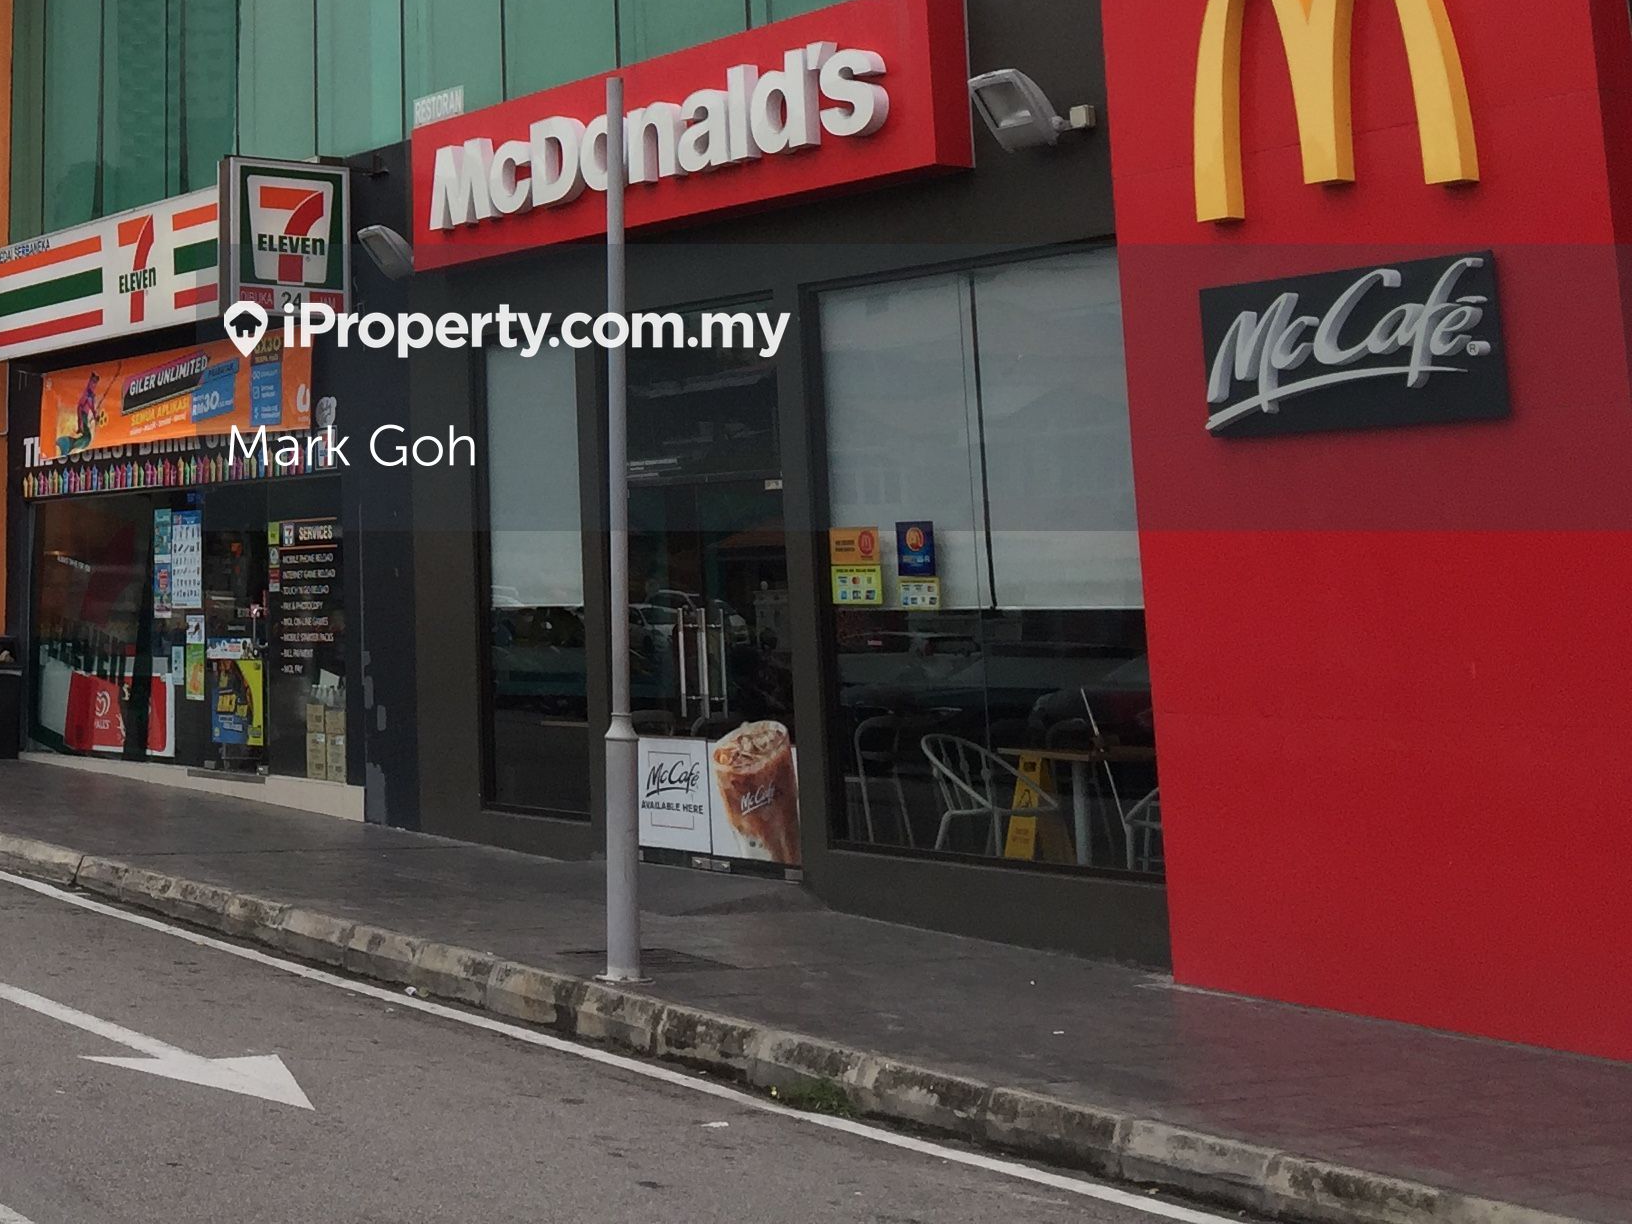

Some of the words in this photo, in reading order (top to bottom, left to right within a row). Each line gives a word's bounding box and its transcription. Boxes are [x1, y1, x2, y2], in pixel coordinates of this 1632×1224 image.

[416, 87, 463, 124] RESTORAN
[429, 41, 889, 231] McDonald's
[260, 186, 324, 283] 7
[118, 214, 155, 324] 7
[281, 291, 302, 311] 24
[129, 376, 156, 397] GILER
[156, 355, 208, 387] UNLIMITED
[298, 524, 333, 541] SERVICES
[646, 759, 700, 796] McCafé
[641, 799, 681, 812] AVAILABLE
[682, 803, 704, 815] HERE
